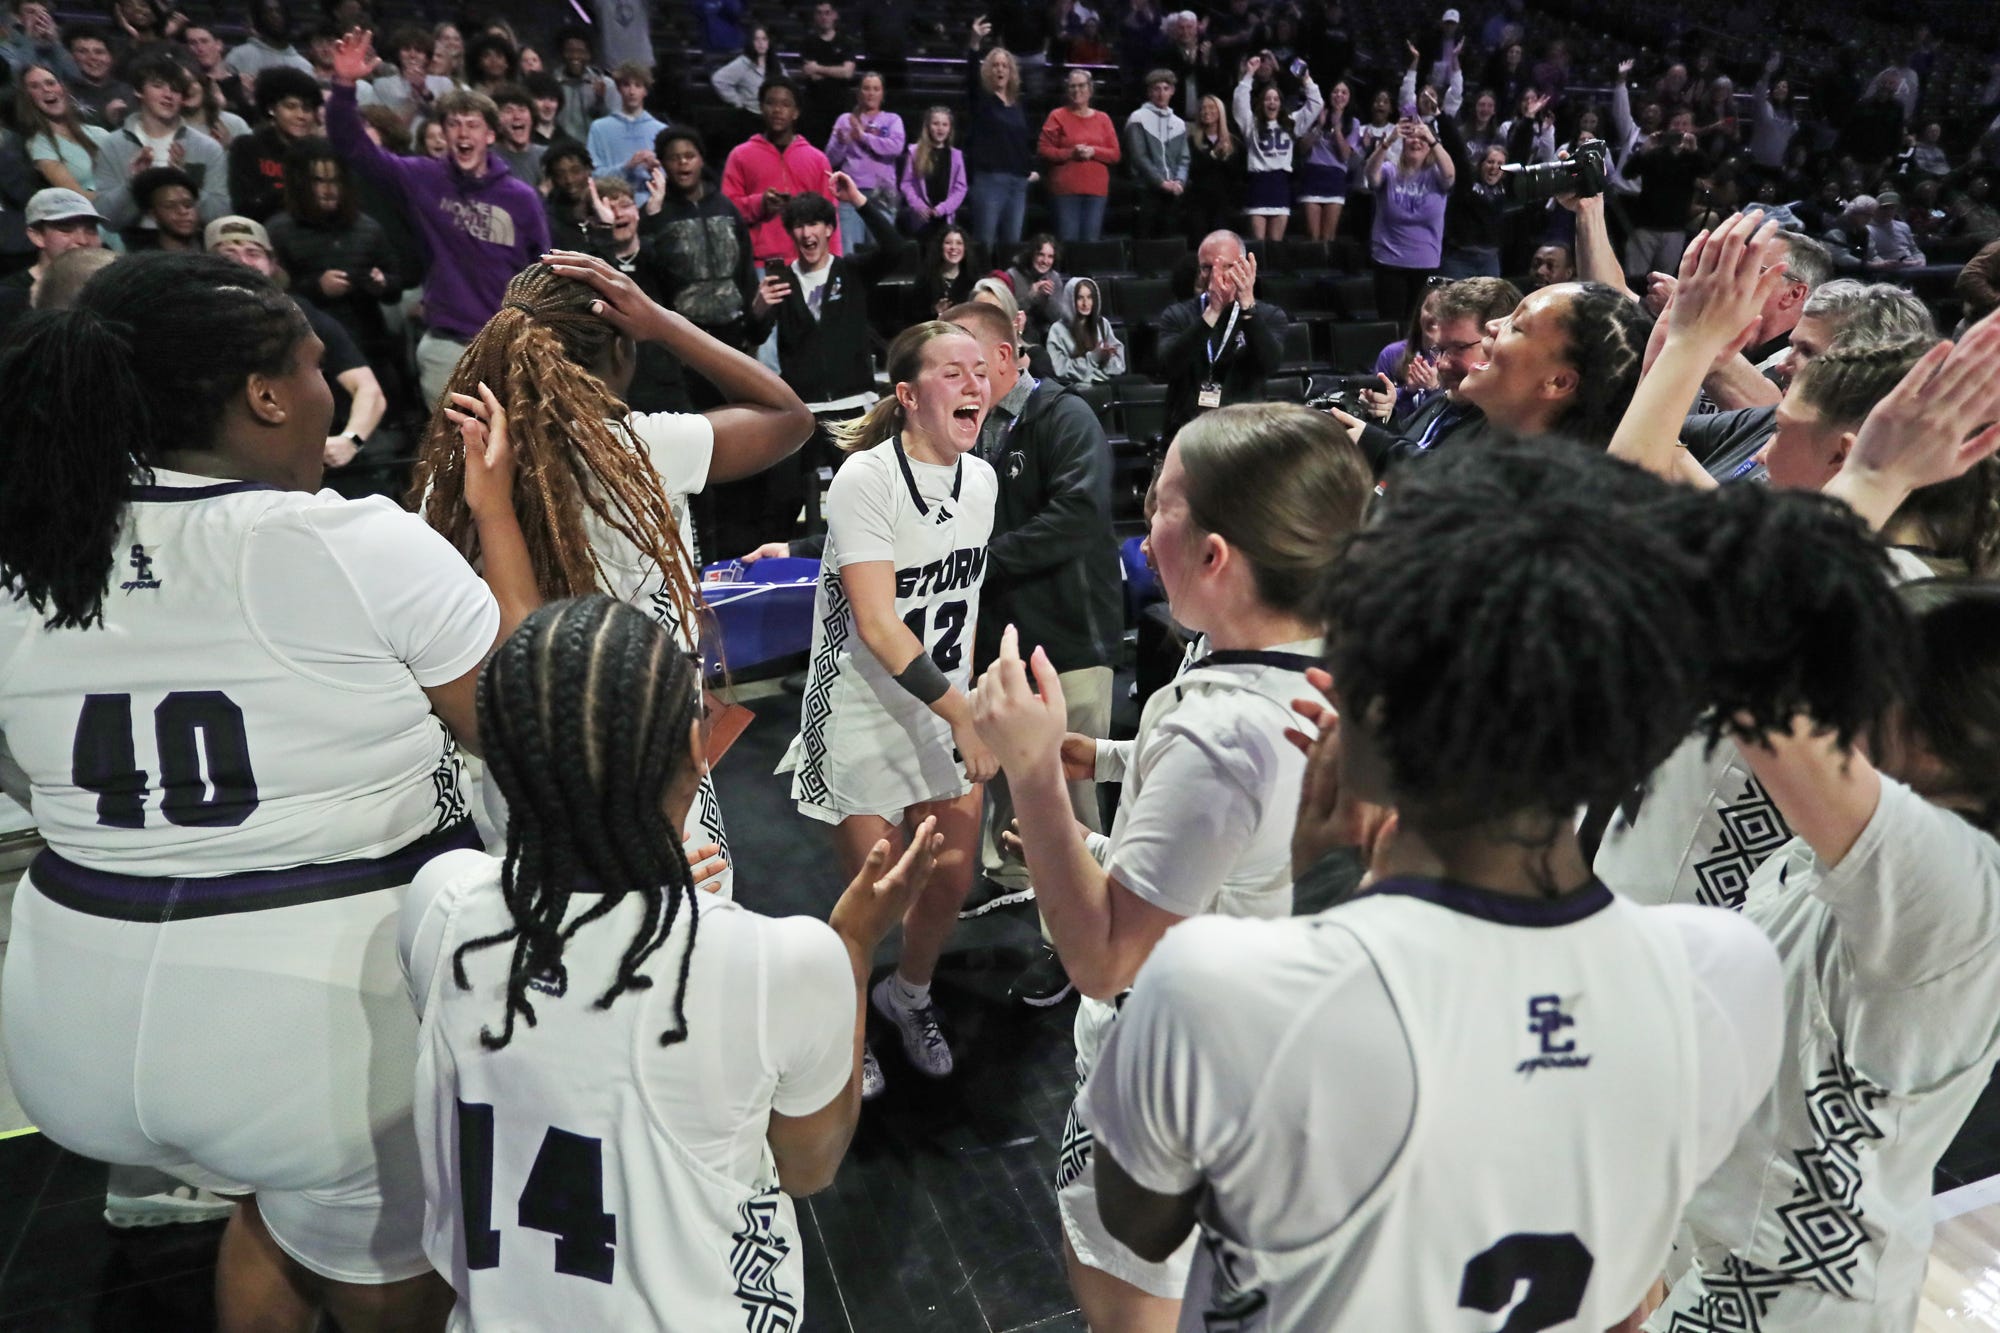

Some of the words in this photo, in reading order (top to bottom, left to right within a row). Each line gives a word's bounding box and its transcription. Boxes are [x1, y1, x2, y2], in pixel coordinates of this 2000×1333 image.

[894, 545, 988, 599] STORM
[902, 600, 968, 673] 12
[72, 690, 260, 829] 40
[1528, 994, 1575, 1053] SC
[457, 1097, 617, 1284] 14
